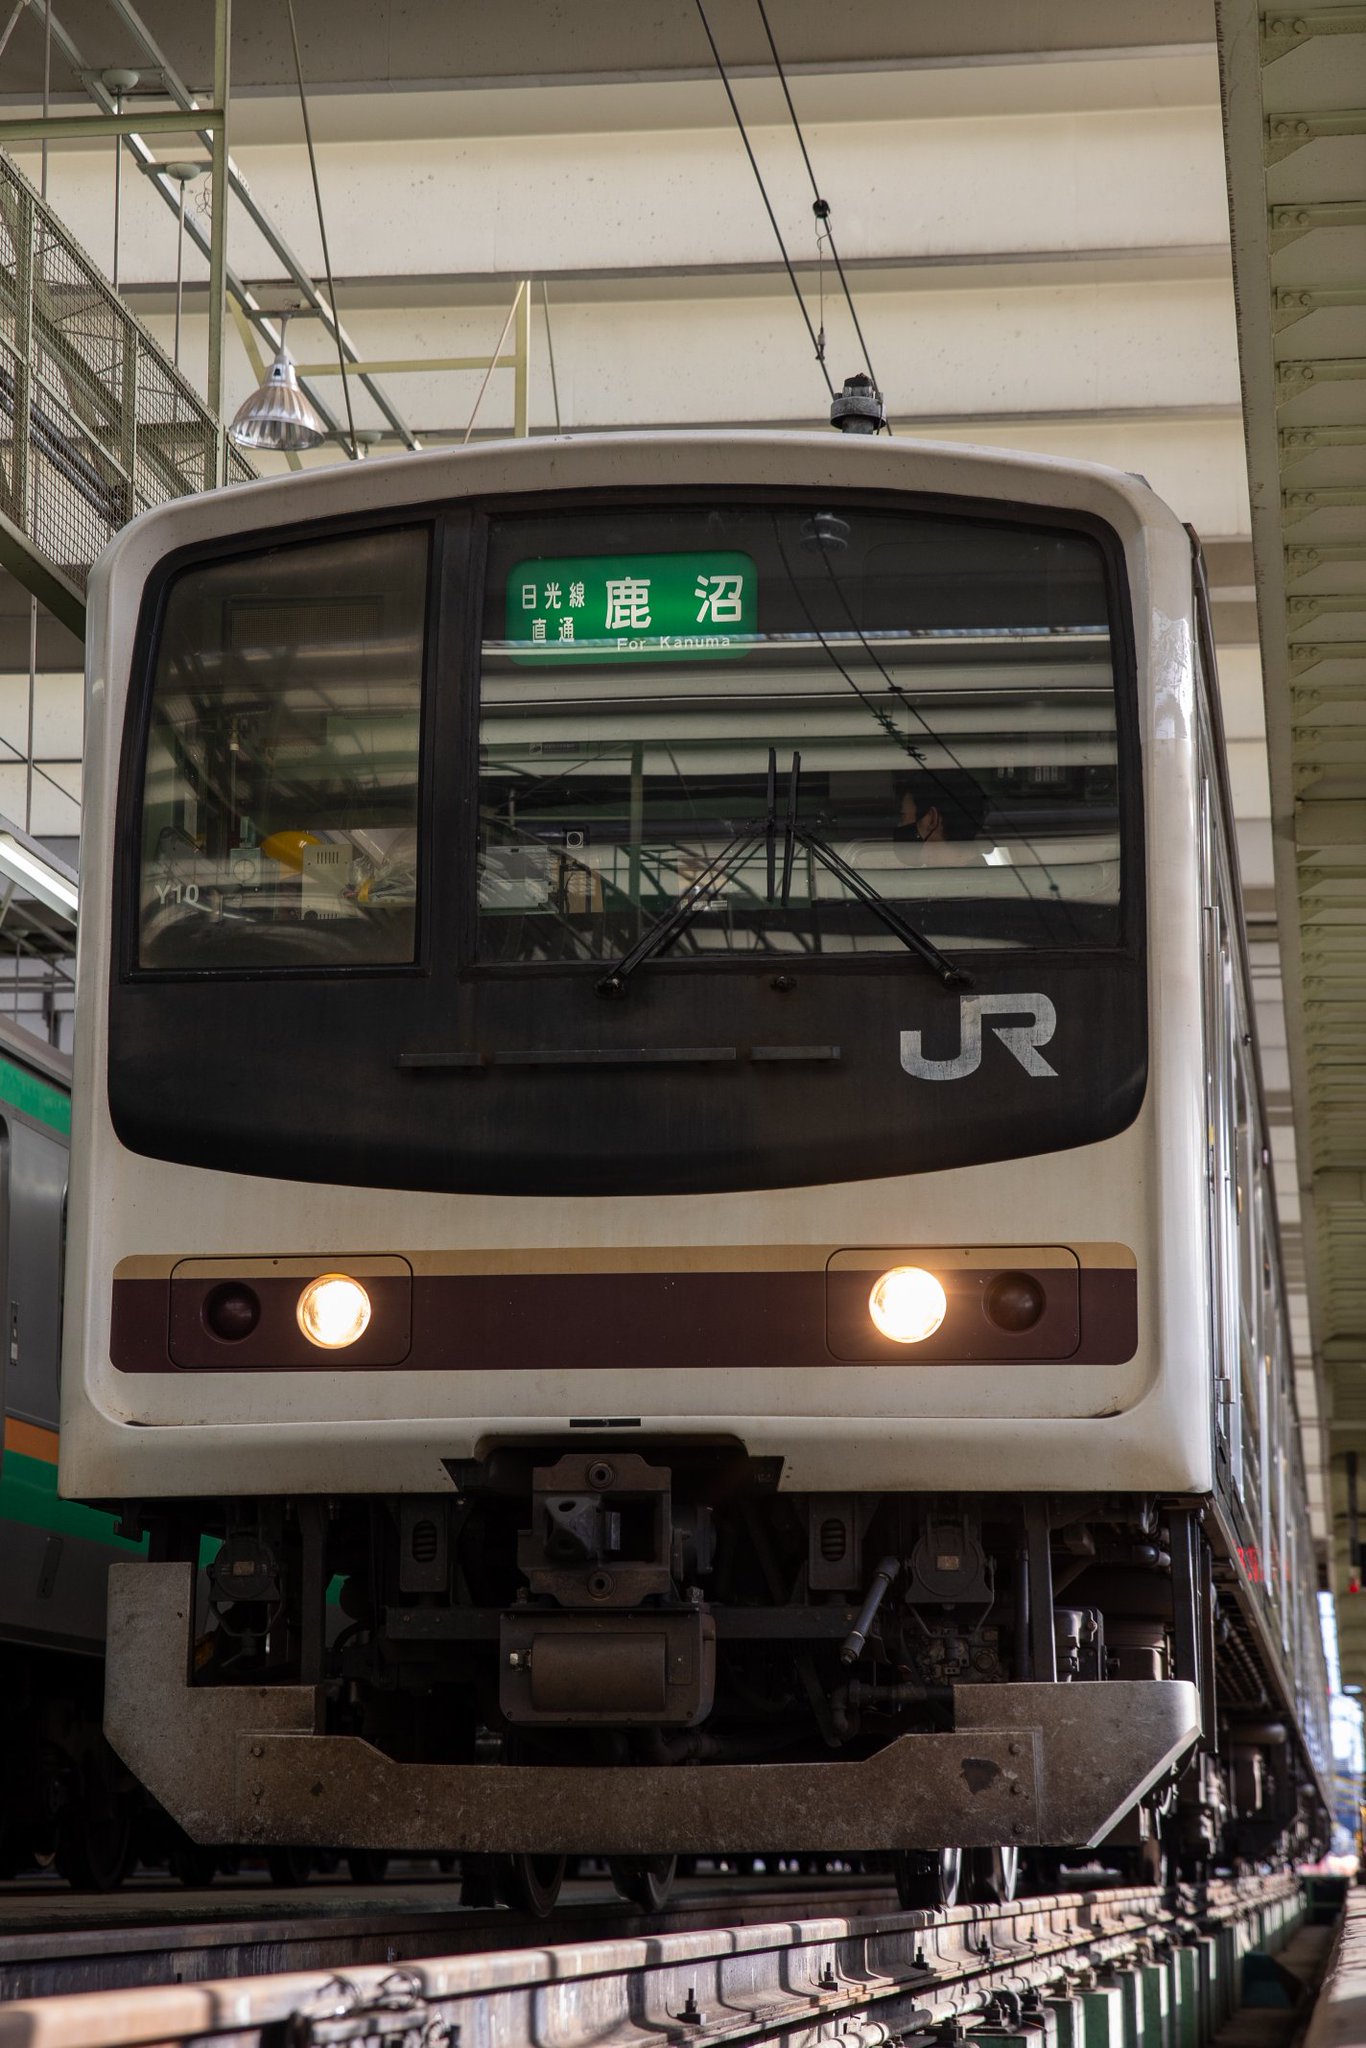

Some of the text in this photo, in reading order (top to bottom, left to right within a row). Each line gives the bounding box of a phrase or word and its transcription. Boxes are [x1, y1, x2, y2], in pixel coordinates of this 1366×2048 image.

[522, 581, 585, 609] 日光線
[604, 575, 743, 629] 鹿沼
[532, 617, 574, 643] 直通
[617, 636, 731, 651] For Kanuma
[155, 884, 200, 905] Y10
[900, 993, 1059, 1081] JR
